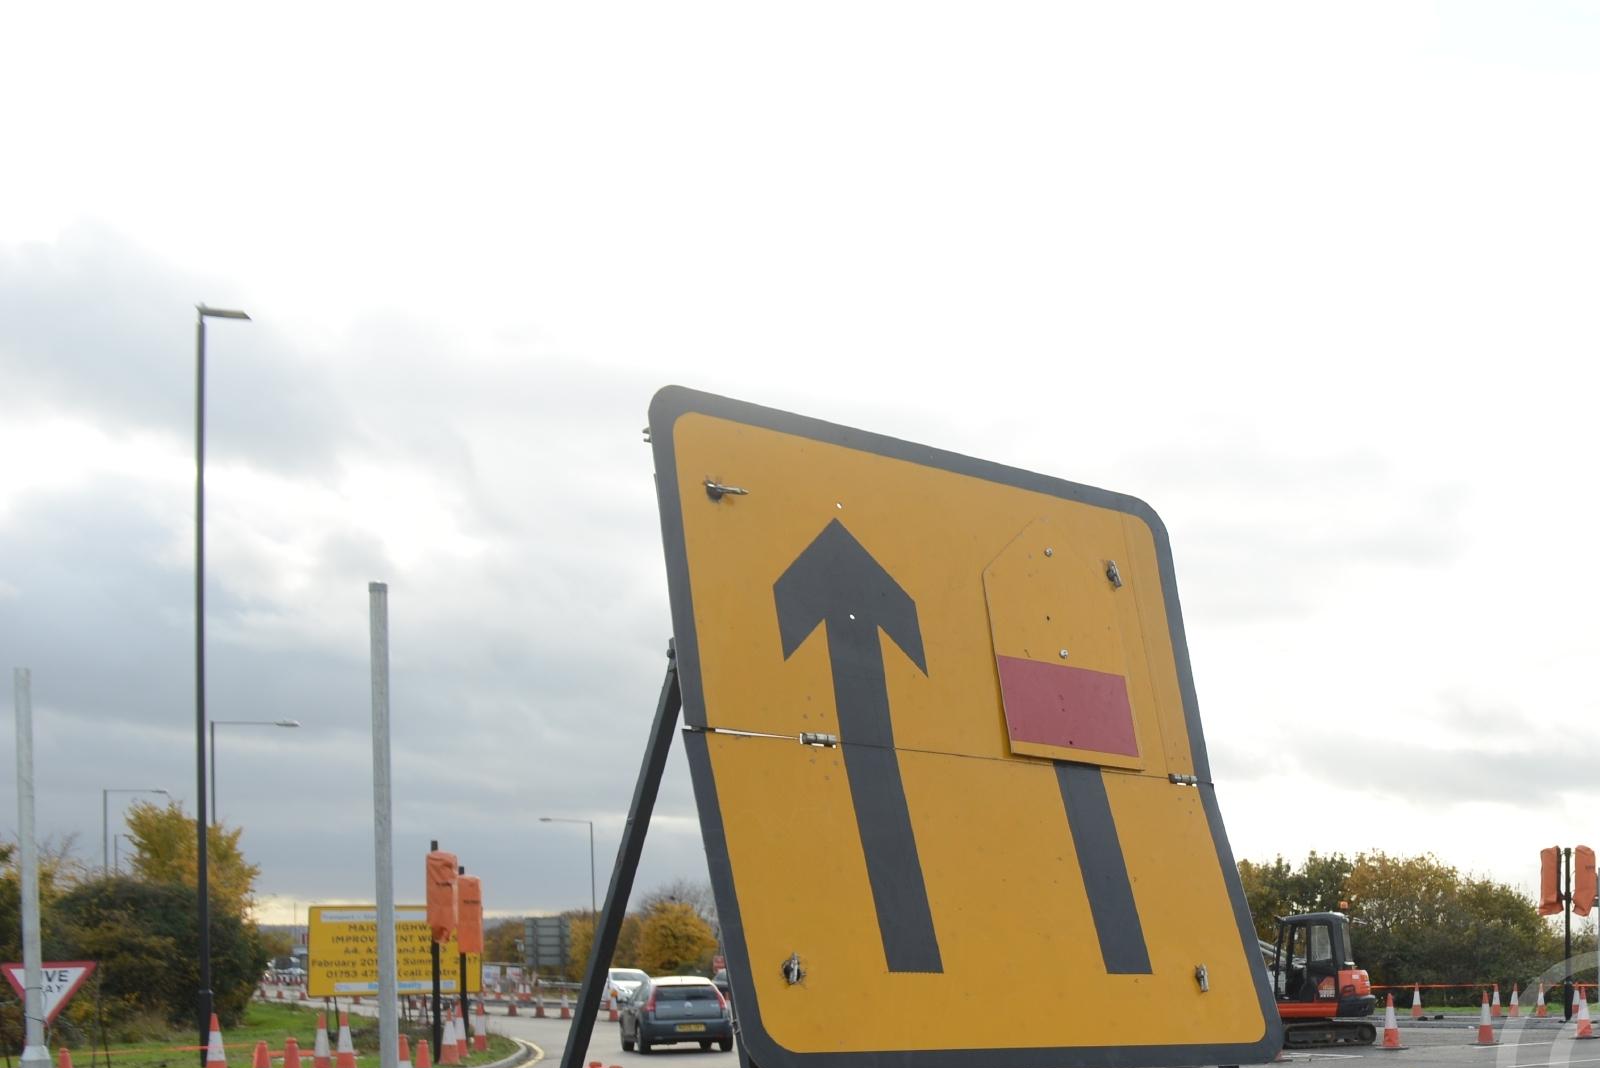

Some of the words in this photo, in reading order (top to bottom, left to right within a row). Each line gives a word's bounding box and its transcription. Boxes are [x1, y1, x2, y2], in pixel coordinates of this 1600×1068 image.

[348, 923, 377, 932] MAJO
[331, 934, 414, 944] IMPROVNT
[311, 959, 357, 968] February
[360, 958, 378, 967] 201
